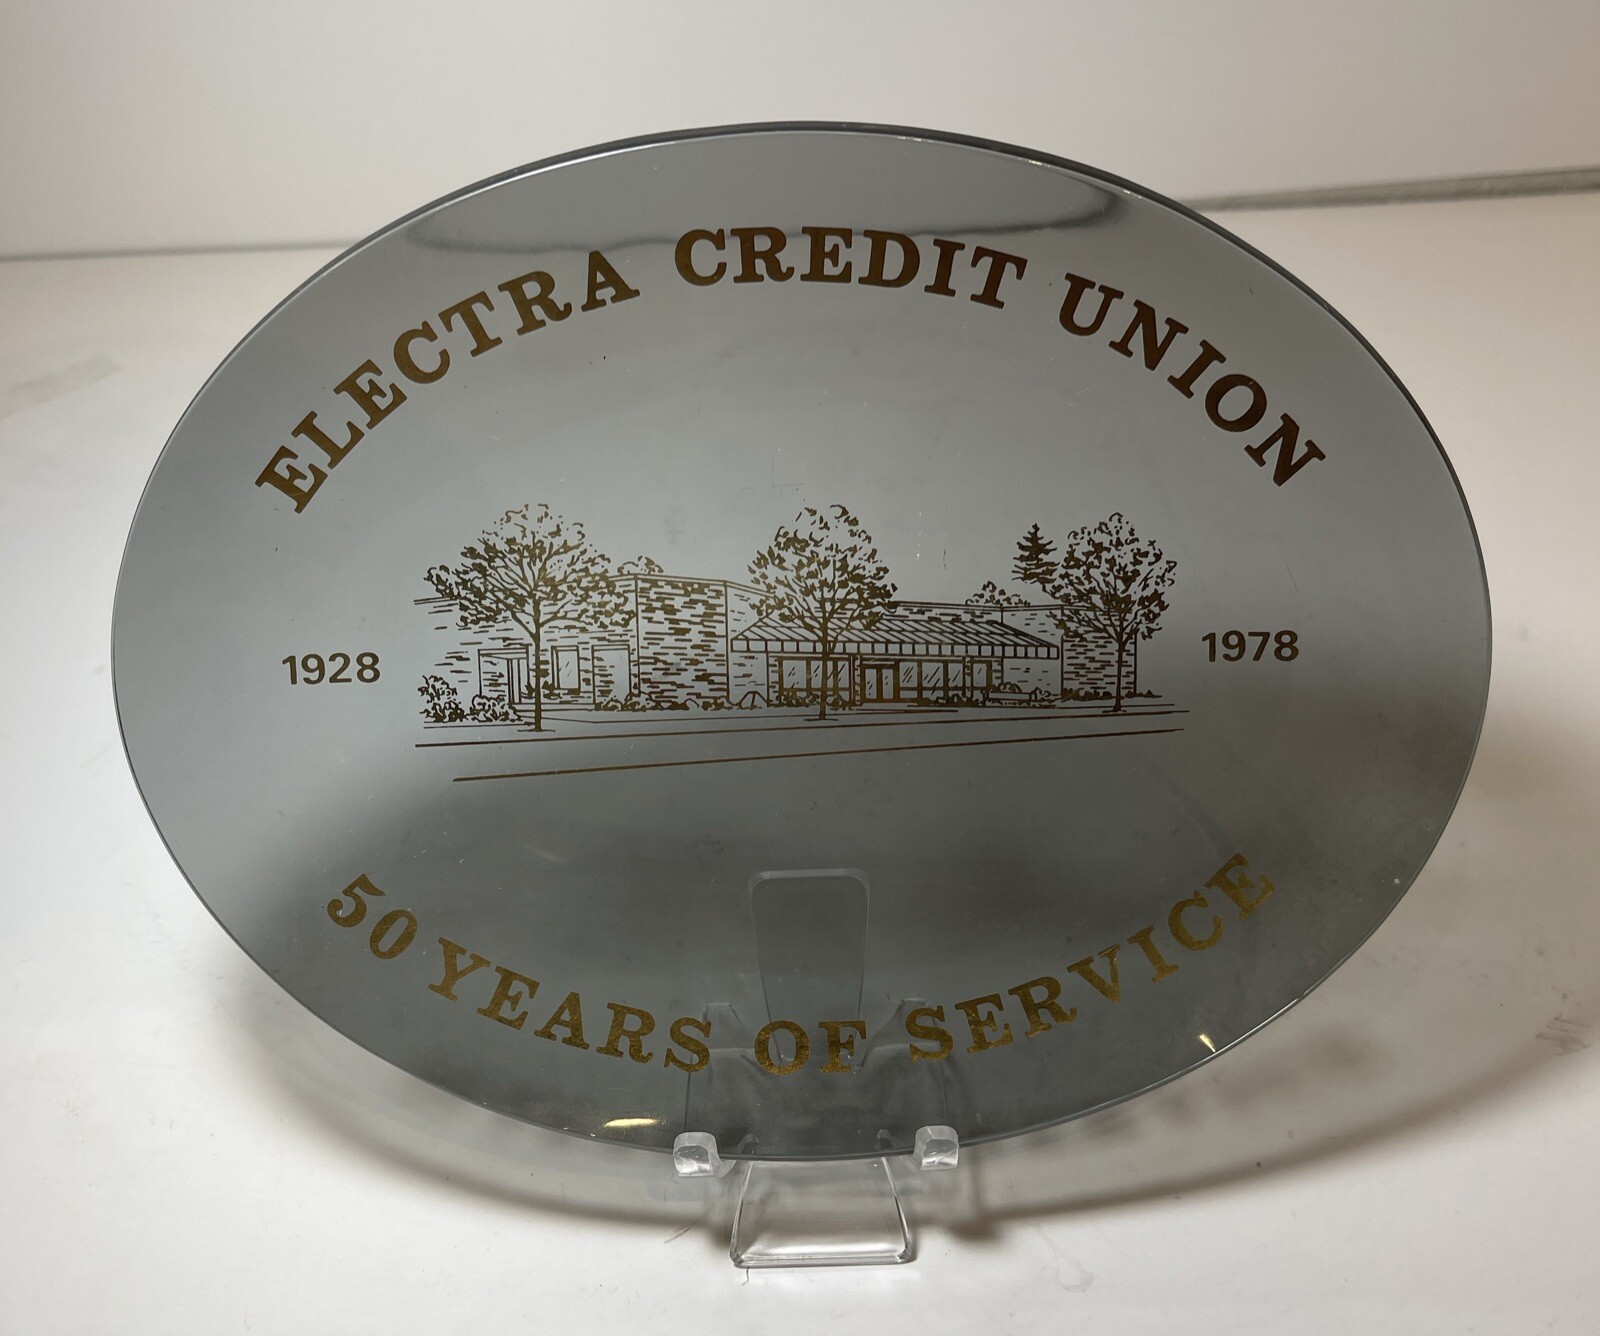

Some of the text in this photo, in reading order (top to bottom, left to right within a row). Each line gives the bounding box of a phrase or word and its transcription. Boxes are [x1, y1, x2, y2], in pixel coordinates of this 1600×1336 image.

[256, 226, 1326, 513] ELECTRA CREDIT UNION
[282, 652, 381, 685] 1928
[1202, 630, 1299, 662] 1978
[327, 853, 1277, 1076] 50 YEARS OF SERVICE
